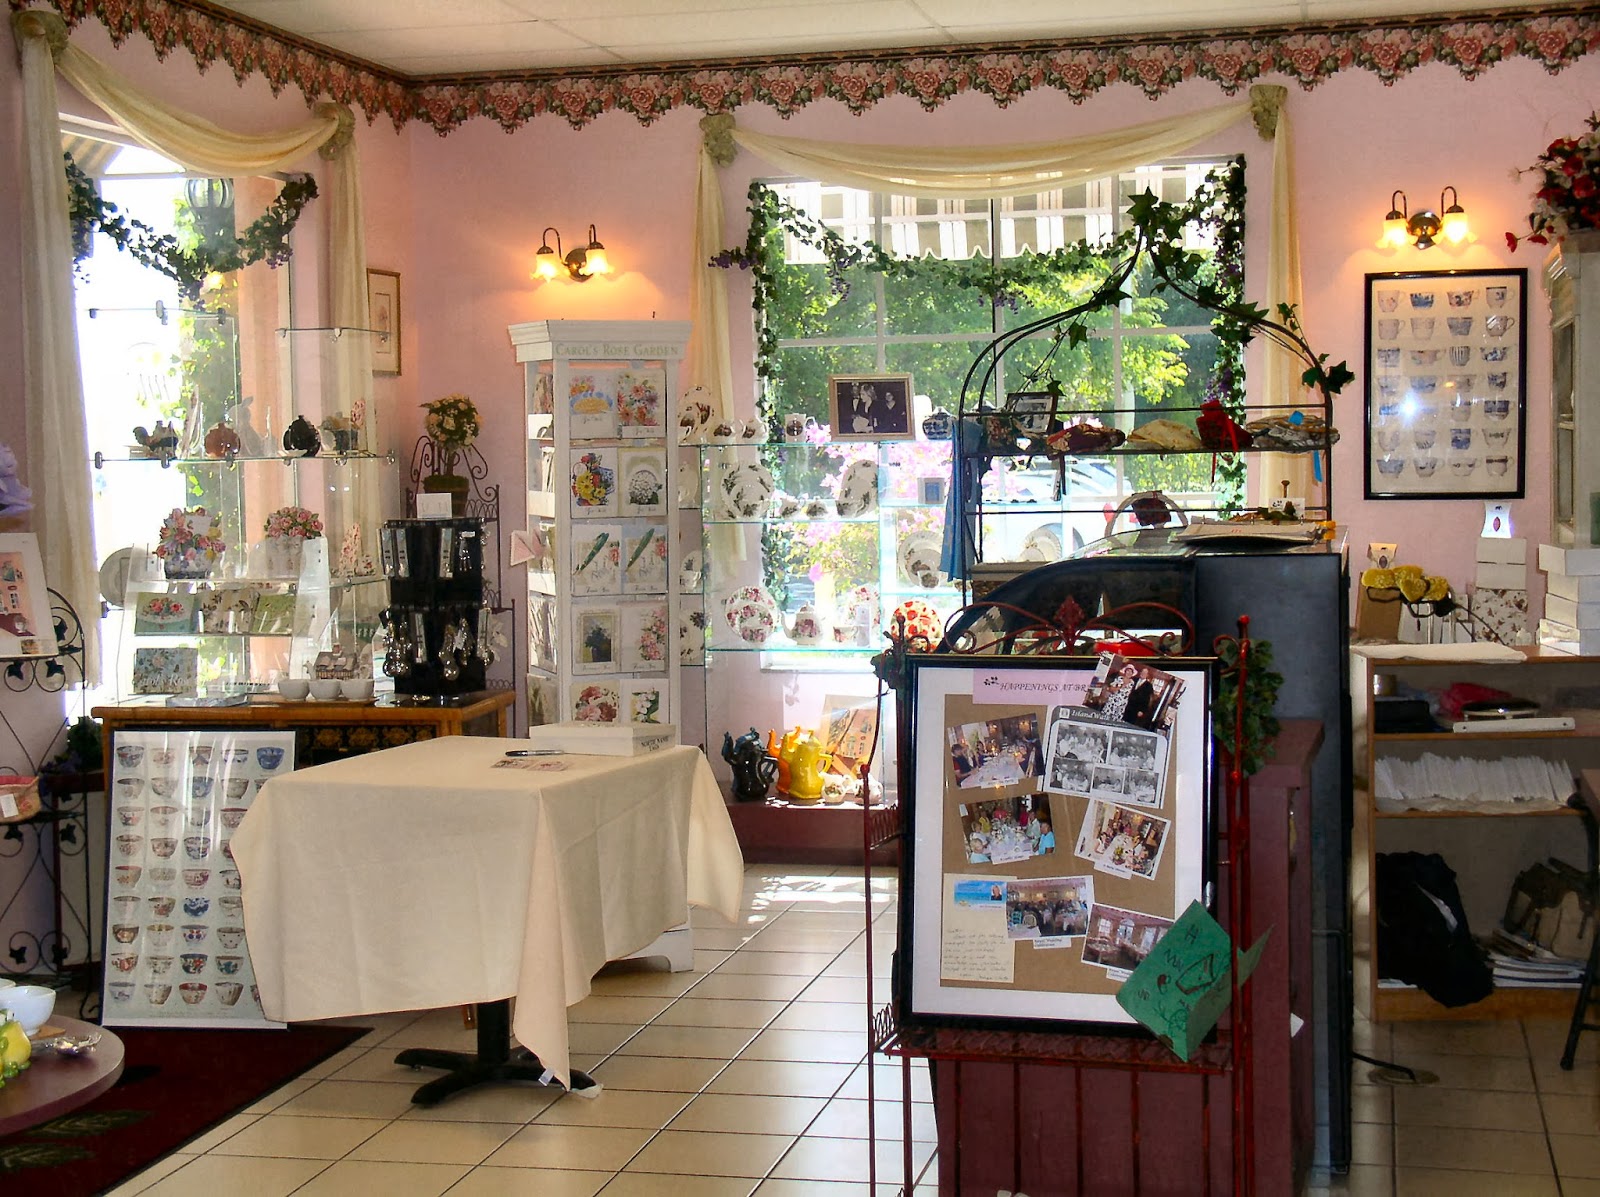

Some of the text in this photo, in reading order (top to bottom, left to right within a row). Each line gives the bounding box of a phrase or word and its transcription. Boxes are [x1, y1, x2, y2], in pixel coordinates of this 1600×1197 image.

[555, 343, 678, 356] CAROL'S ROSE GARDEN
[1000, 682, 1089, 693] HAPPENINGS AT BR
